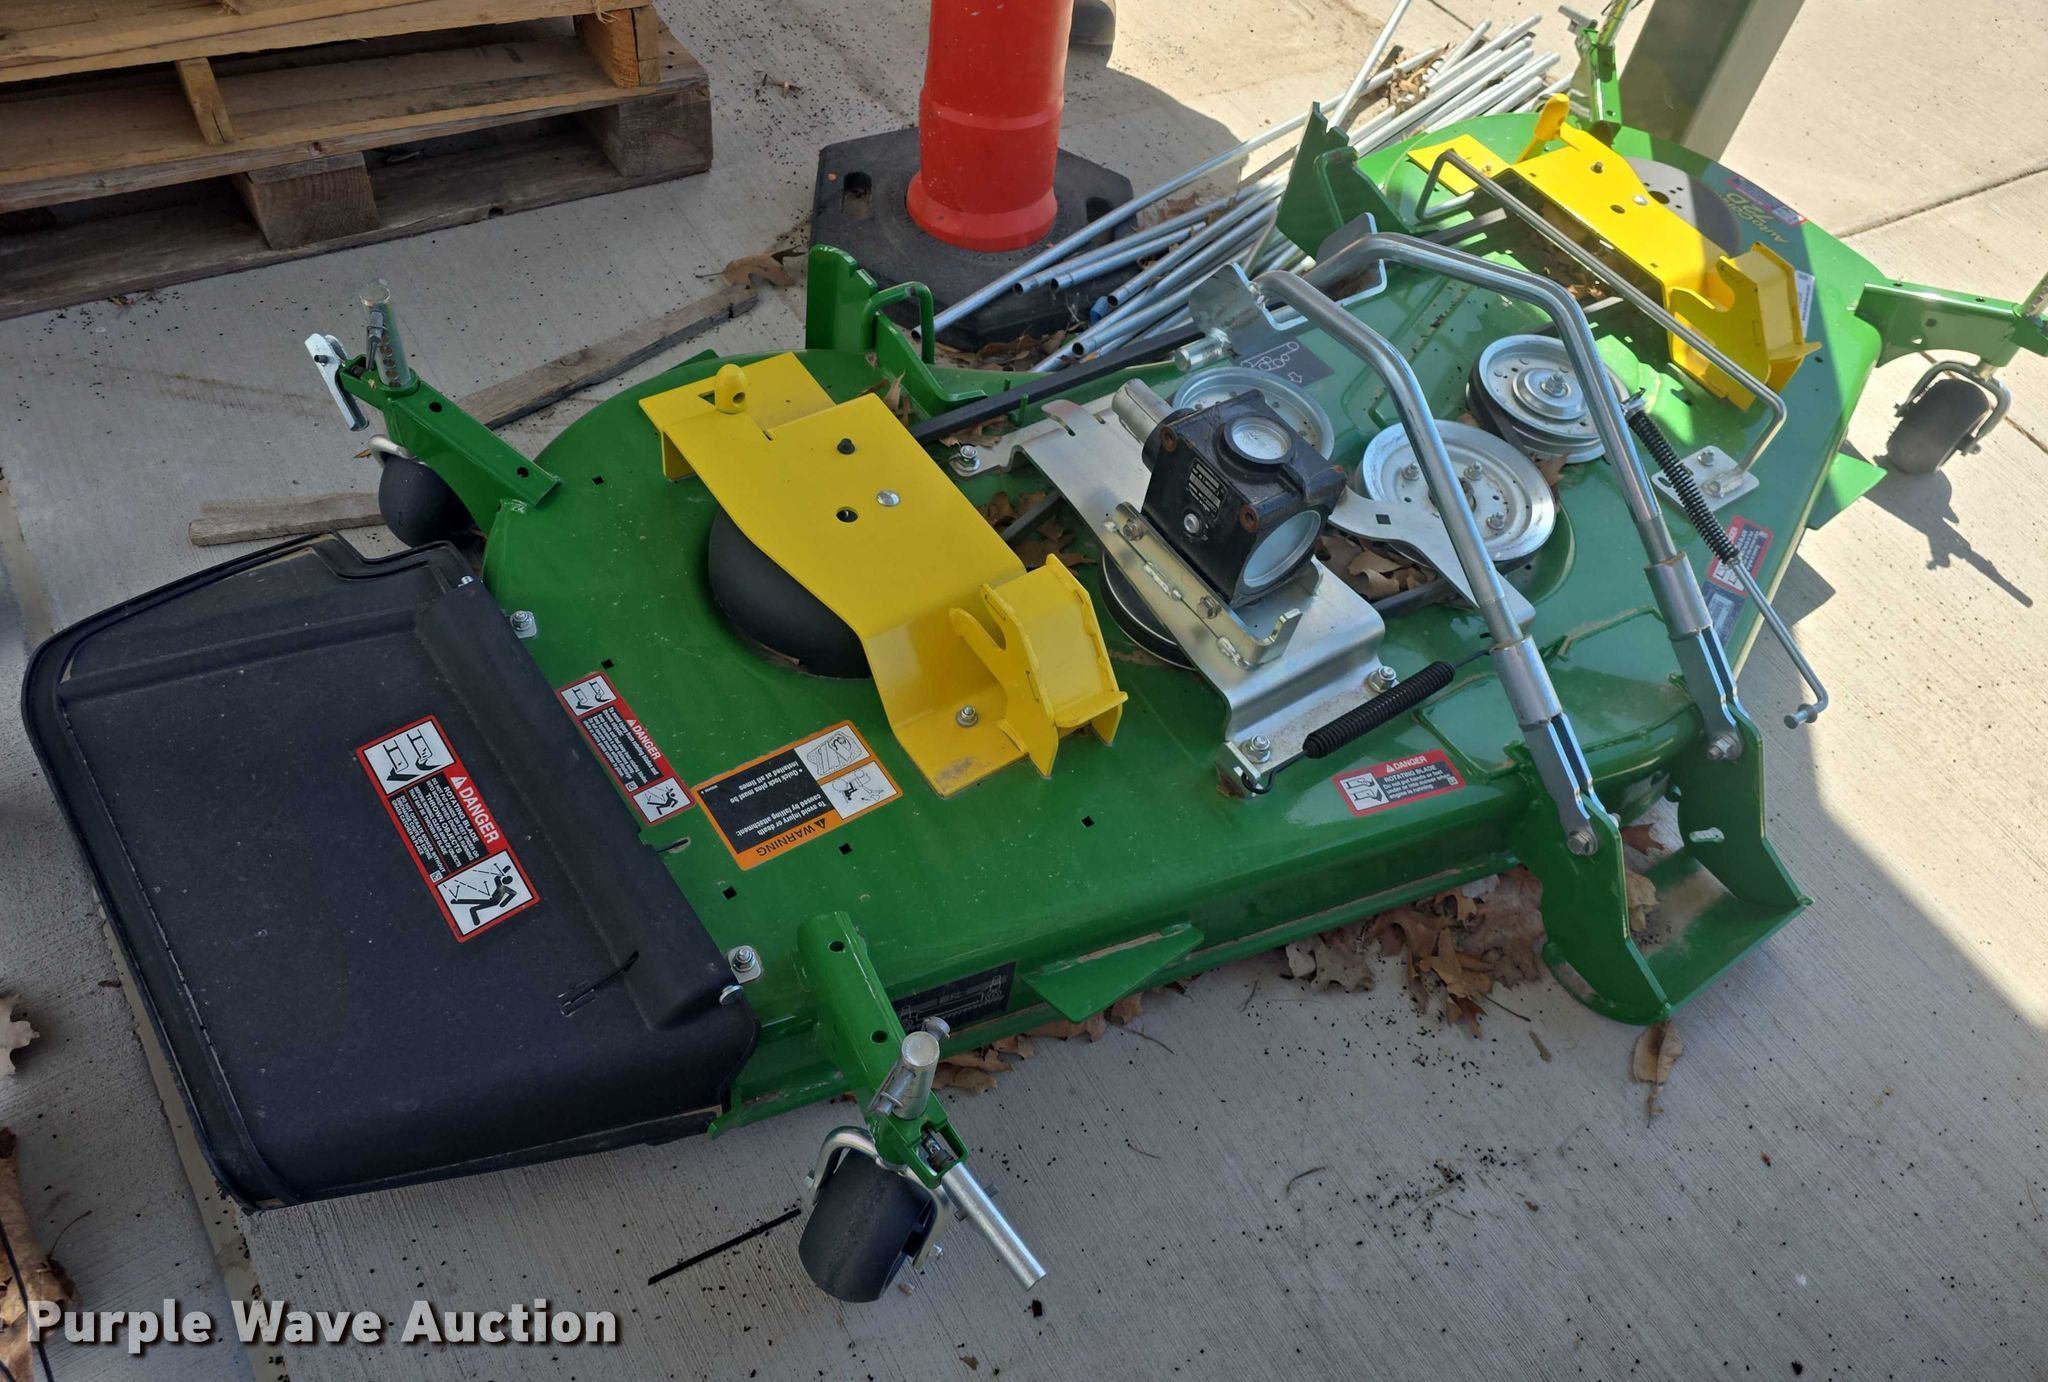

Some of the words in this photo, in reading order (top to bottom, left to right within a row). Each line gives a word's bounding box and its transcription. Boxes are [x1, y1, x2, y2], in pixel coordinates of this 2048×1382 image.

[631, 724, 662, 760] DANGER
[770, 759, 799, 777] installed
[1391, 754, 1428, 770] DANGER
[754, 774, 767, 784] all
[763, 771, 774, 780] at
[778, 767, 799, 781] Quick
[1382, 769, 1416, 783] ROTATING
[1413, 763, 1437, 774] BLADE
[737, 778, 758, 792] times
[751, 781, 769, 793] pins
[766, 775, 782, 787] lock
[728, 794, 740, 804] be
[736, 787, 755, 800] must
[797, 791, 823, 808] caused
[789, 801, 801, 812] by
[799, 802, 819, 816] avoid
[815, 798, 827, 809] To
[439, 792, 449, 803] PUT
[456, 822, 467, 836] FEET
[442, 785, 466, 820] ROTATING
[461, 818, 479, 843] BLADE
[457, 785, 501, 844] DANGER
[769, 805, 793, 821] falling
[781, 810, 802, 825] injury
[423, 792, 445, 823] THROWN
[440, 821, 463, 854] OBJECTS
[733, 814, 773, 838] attachment:
[755, 822, 777, 837] death
[773, 818, 784, 828] or
[754, 822, 816, 857] WARNING
